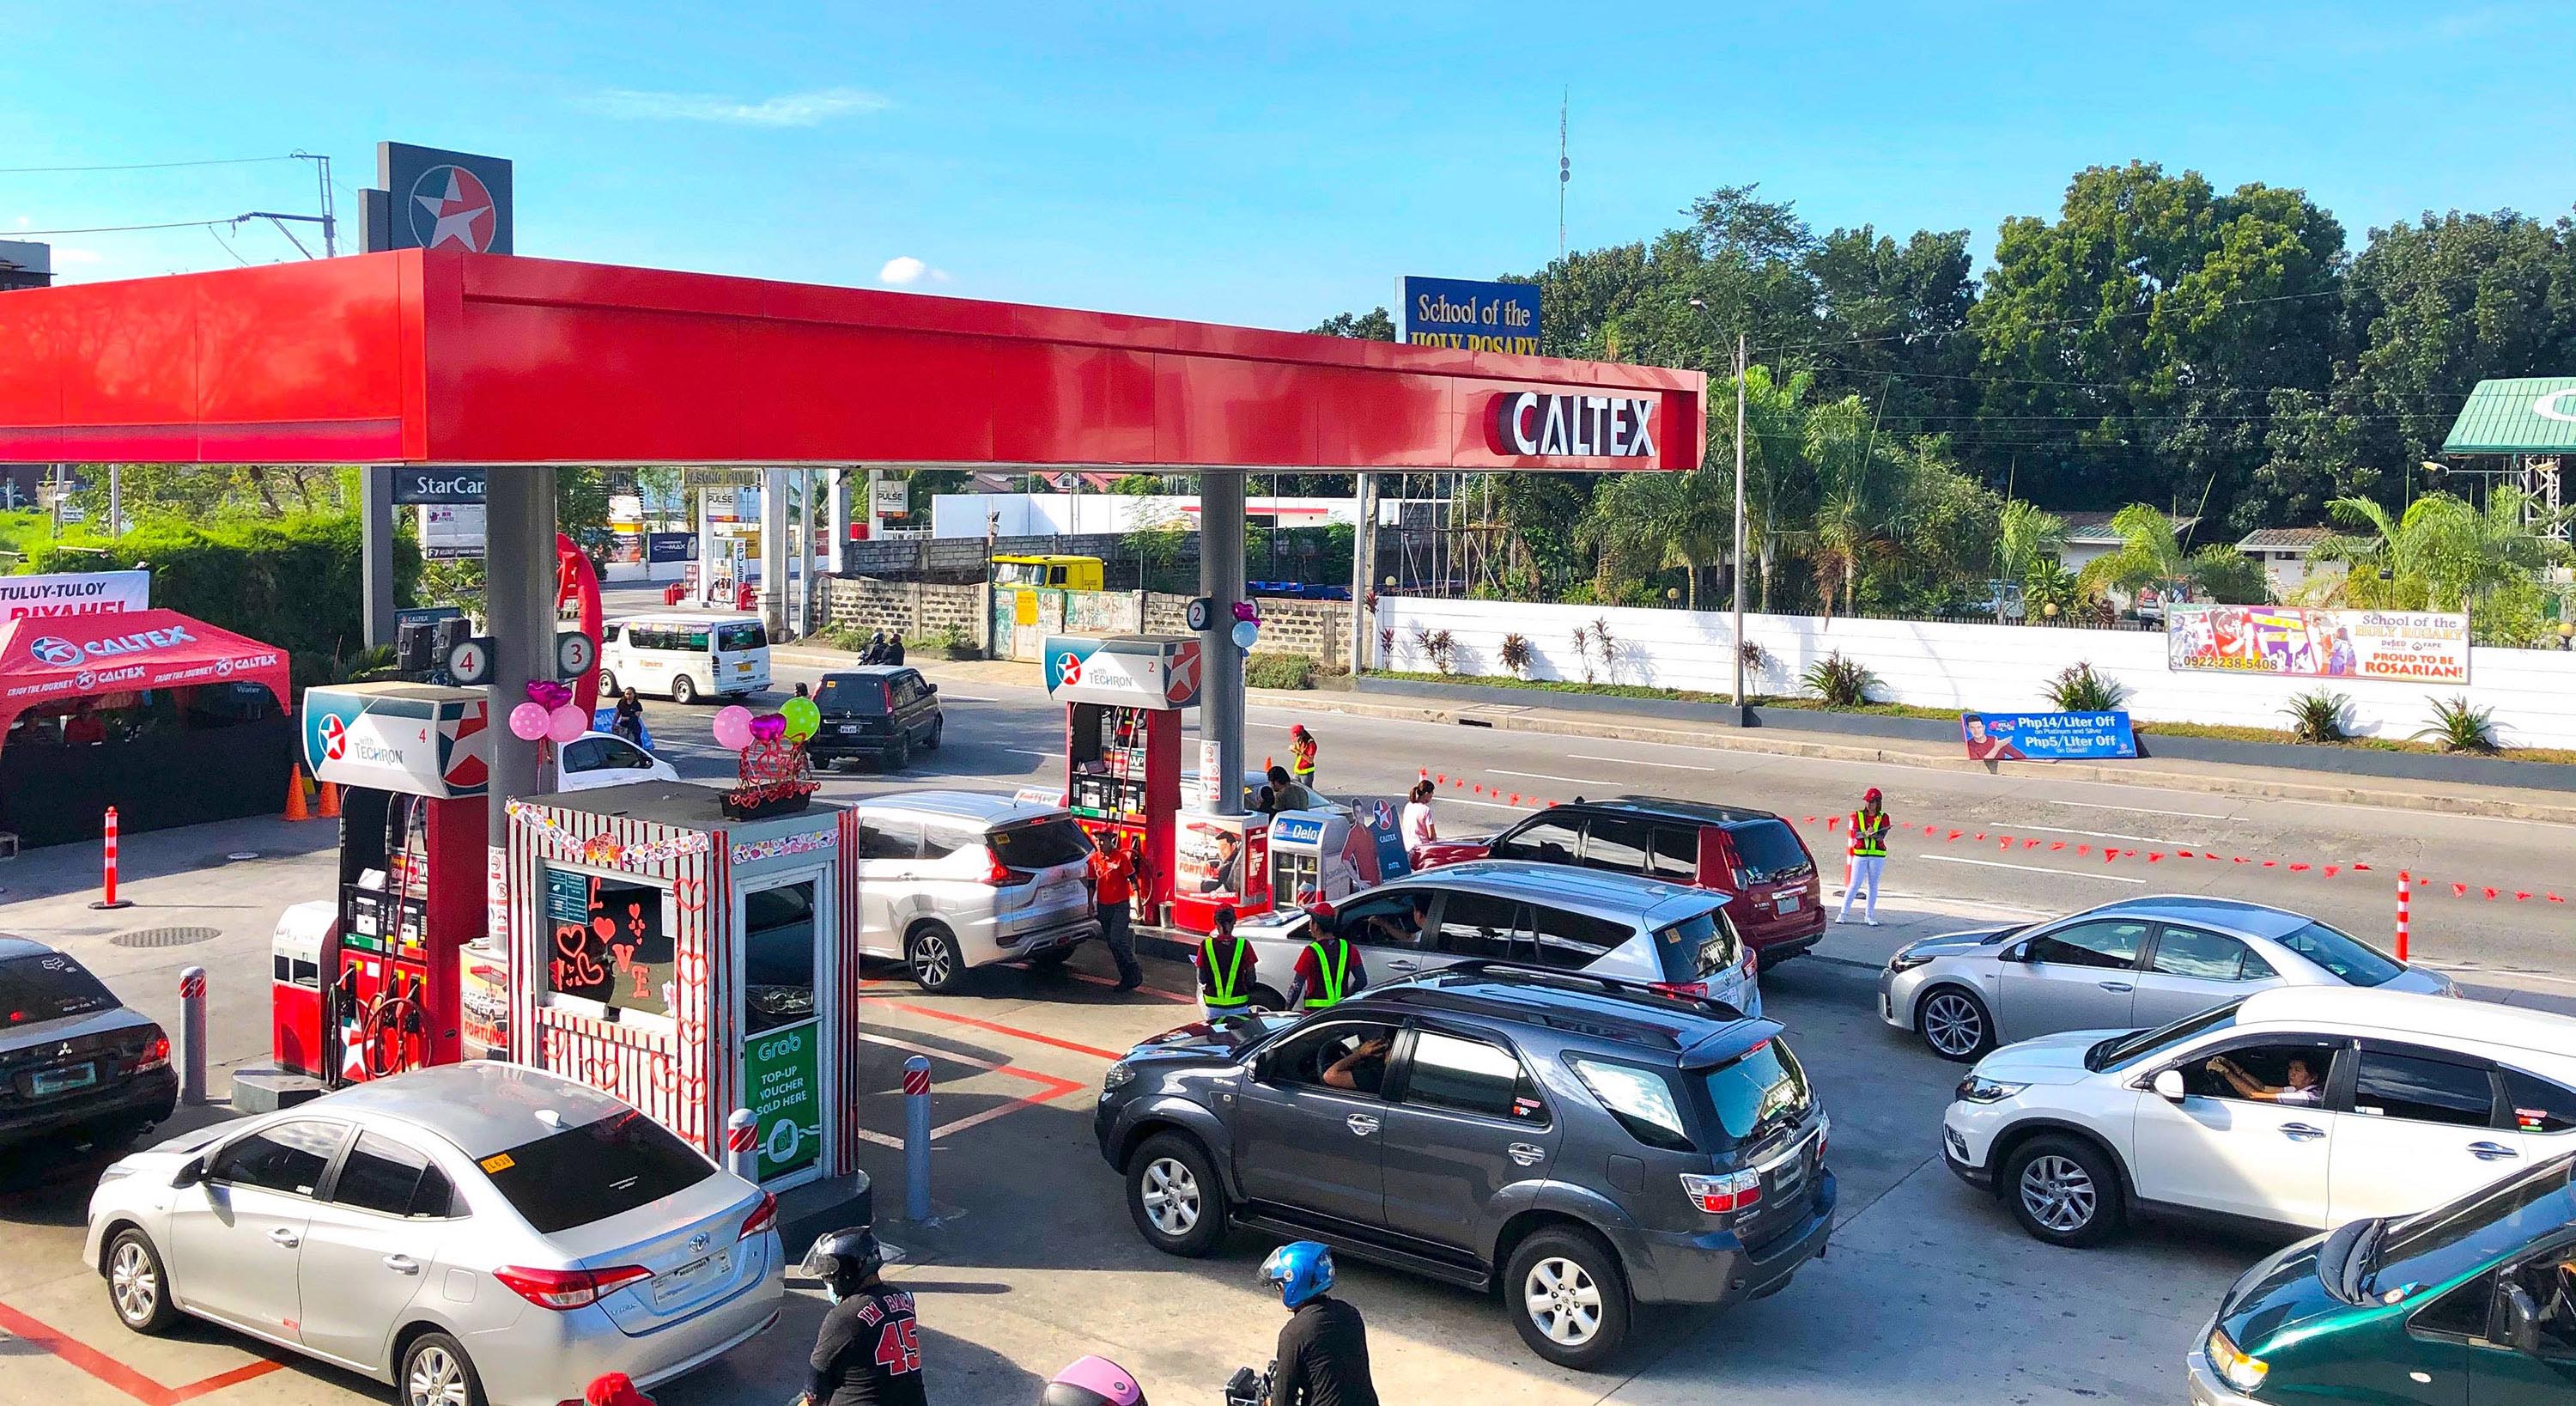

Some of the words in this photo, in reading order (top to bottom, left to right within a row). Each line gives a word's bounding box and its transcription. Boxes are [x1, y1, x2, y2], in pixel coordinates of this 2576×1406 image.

[1419, 294, 1478, 325] School
[1481, 298, 1500, 326] of
[1504, 298, 1531, 327] the
[1512, 392, 1656, 456] CALTEX
[416, 477, 487, 494] StarCar
[0, 582, 106, 601] TULUY-TULOY
[1192, 607, 1201, 622] 2
[2362, 615, 2409, 626] School
[2414, 617, 2429, 627] of
[2433, 618, 2457, 628] the
[84, 625, 197, 656] CALTEX
[2355, 625, 2397, 637] HOLY
[2401, 627, 2464, 641] ROSARY
[234, 654, 277, 670] CALTEX
[459, 651, 475, 673] 4
[570, 644, 582, 665] 3
[2184, 655, 2278, 669] 0922-238-5408
[2372, 653, 2417, 662] PROUD
[2420, 654, 2437, 664] TO
[2439, 656, 2455, 665] BE
[97, 666, 146, 683] CALTEX
[1093, 666, 1107, 675] with
[1147, 661, 1155, 673] 2
[2365, 661, 2464, 678] ROSARIAN!
[1088, 672, 1133, 688] TECHRON
[237, 685, 261, 694] Water
[2018, 716, 2093, 730] Php14/Liter
[2095, 716, 2116, 727] Off
[359, 736, 374, 746] with
[418, 729, 427, 744] 4
[2025, 735, 2093, 749] Php5/Liter
[2096, 735, 2116, 746] Off
[354, 742, 404, 766] TECHRON
[1291, 824, 1317, 840] Delo
[1379, 833, 1397, 843] CALTEX
[758, 1032, 801, 1062] Grab
[761, 1065, 798, 1085] TOP-UP
[759, 1077, 804, 1100] VOUCHER
[756, 1099, 781, 1117] SOLD
[782, 1090, 807, 1107] HERE
[874, 1317, 920, 1376] 45
